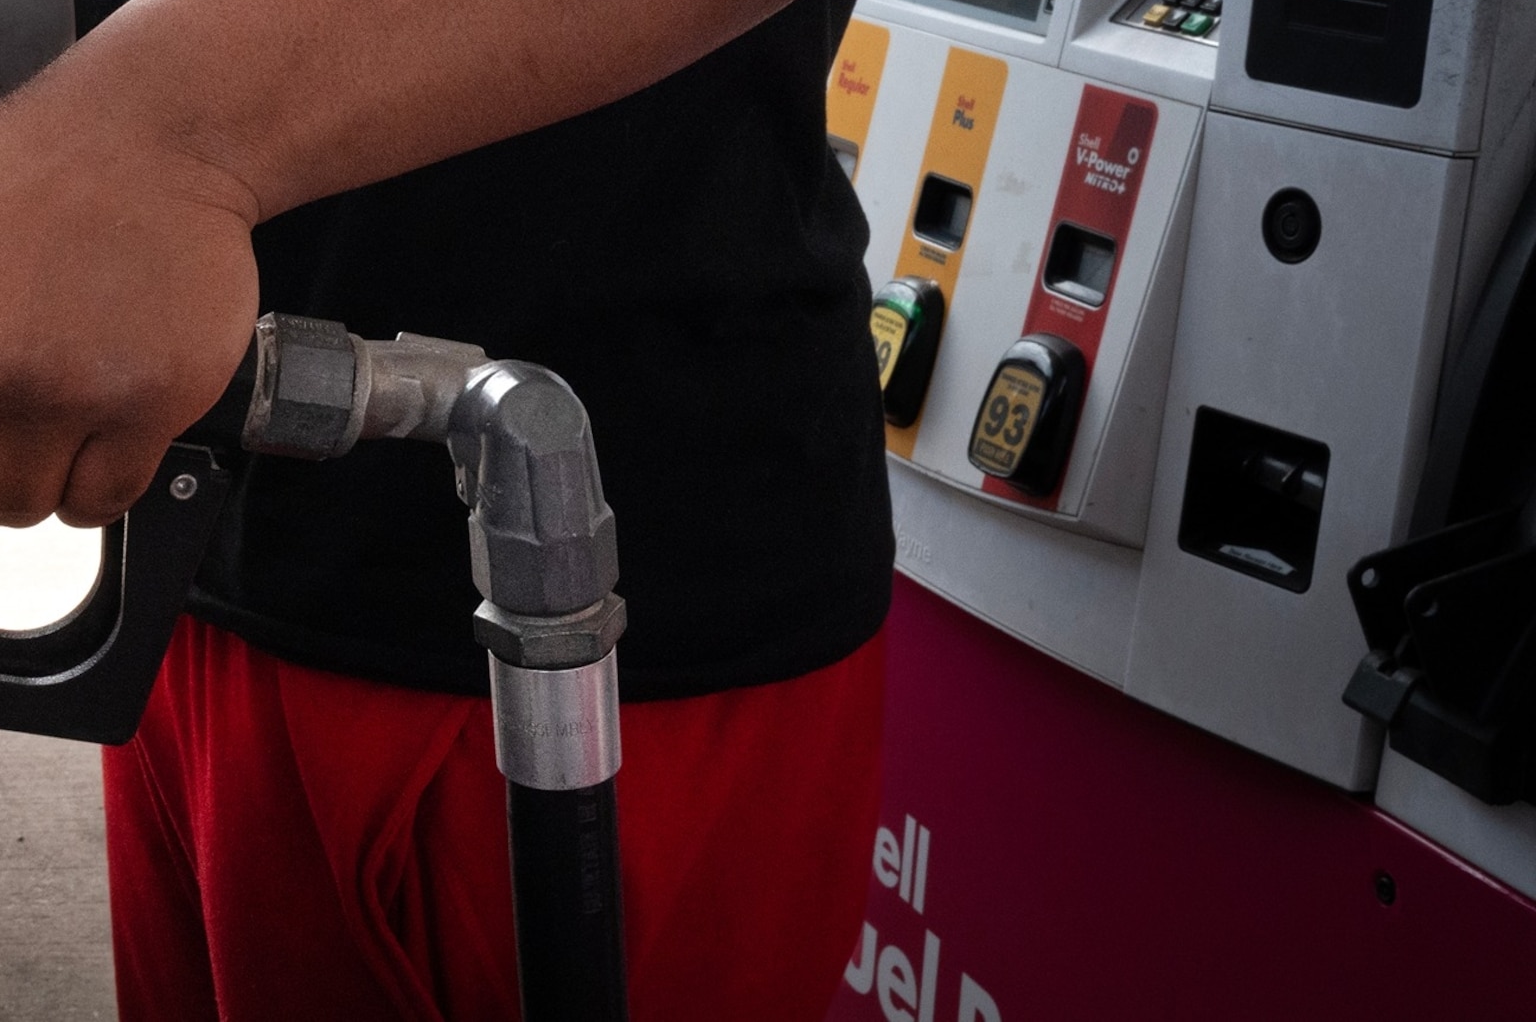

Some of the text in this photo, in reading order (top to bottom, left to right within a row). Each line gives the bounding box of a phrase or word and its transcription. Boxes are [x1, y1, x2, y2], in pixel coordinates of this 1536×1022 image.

[838, 72, 870, 96] Regular
[952, 109, 975, 130] Plus
[957, 95, 975, 111] Shell
[1079, 133, 1101, 150] Shell
[1076, 146, 1130, 179] V-Power
[984, 395, 1030, 446] 93
[895, 525, 931, 563] ayne
[872, 813, 930, 915] ell
[844, 921, 940, 1022] uel
